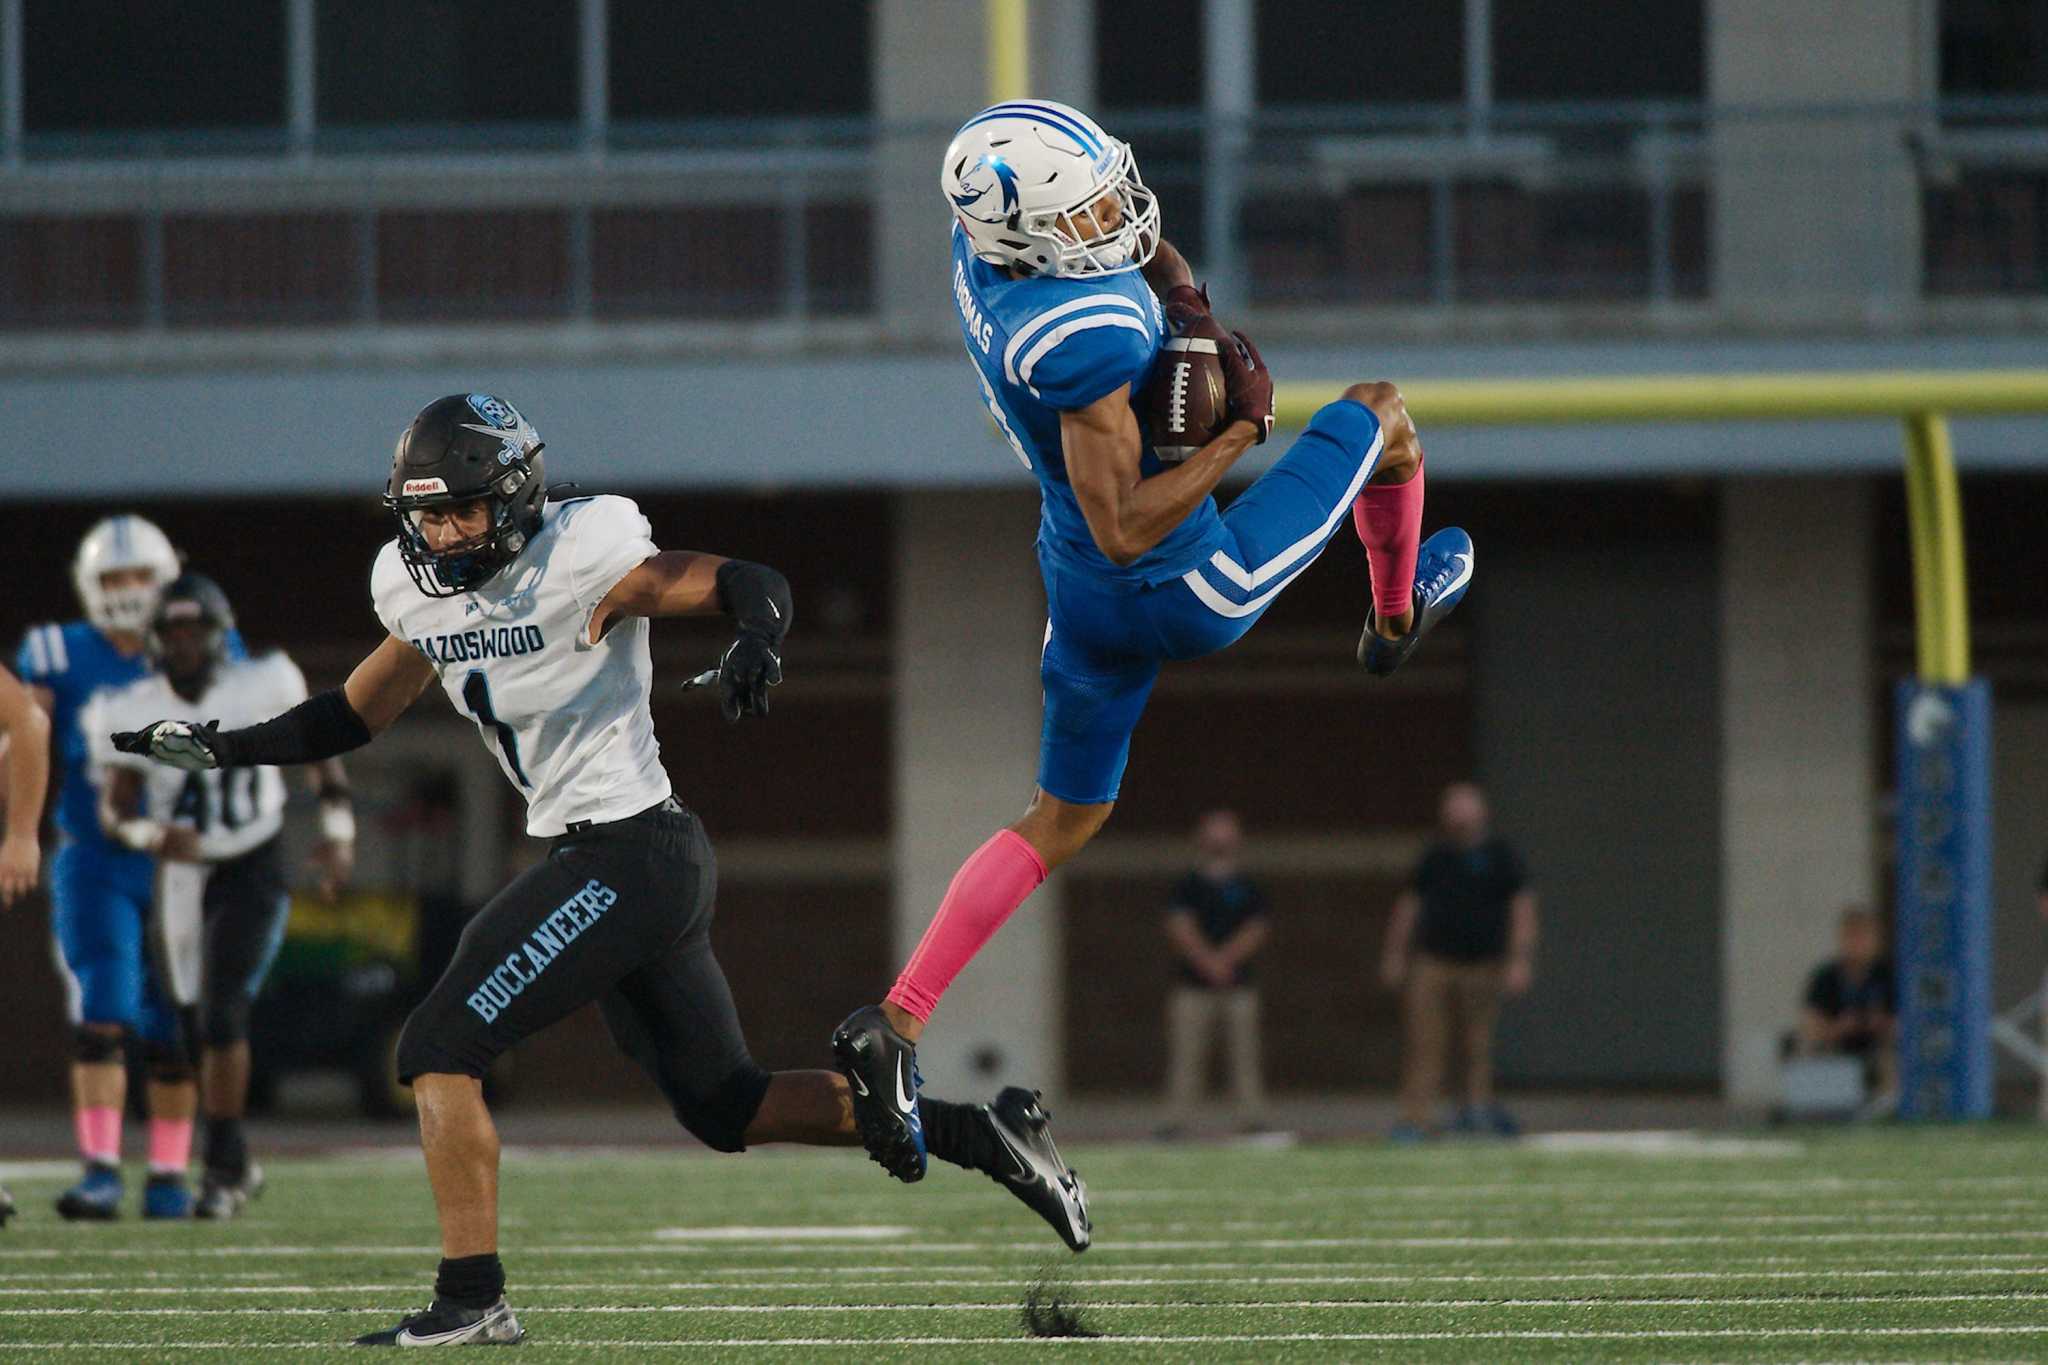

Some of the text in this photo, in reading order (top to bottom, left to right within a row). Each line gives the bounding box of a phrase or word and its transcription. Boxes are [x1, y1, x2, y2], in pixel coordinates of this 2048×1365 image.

[953, 259, 993, 354] THOMAS
[406, 481, 439, 492] Riddell
[462, 668, 534, 790] 1
[466, 878, 618, 1025] BUCCANEERS
